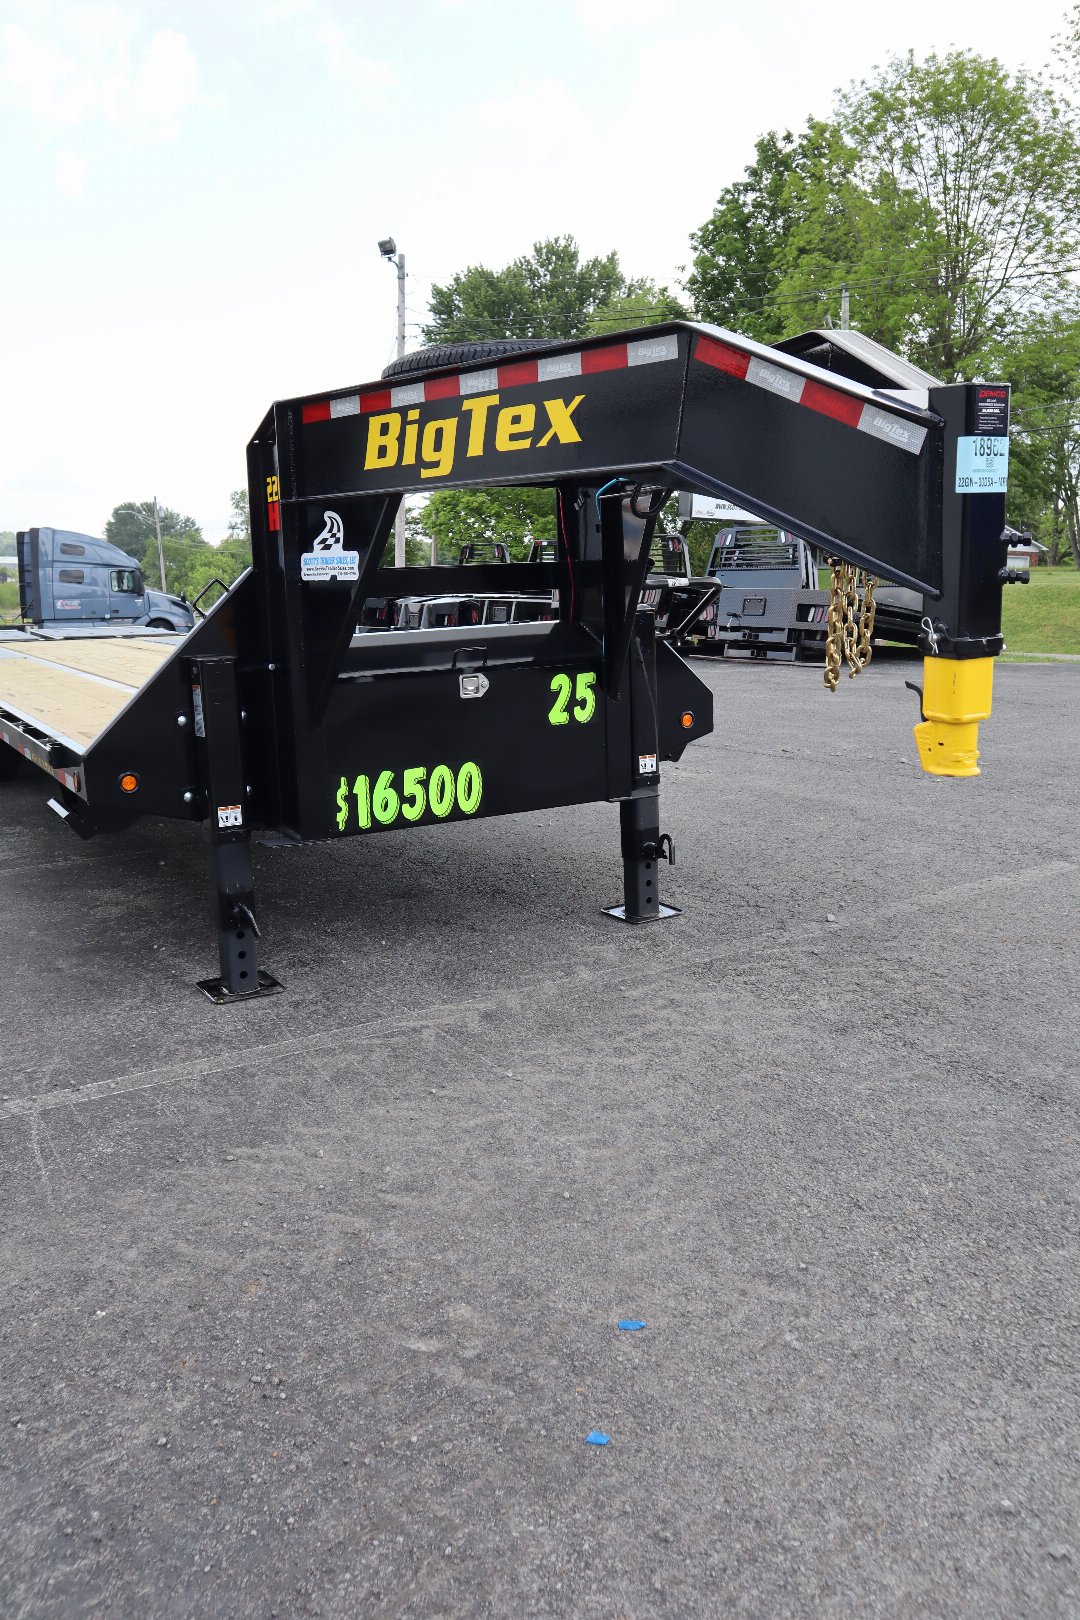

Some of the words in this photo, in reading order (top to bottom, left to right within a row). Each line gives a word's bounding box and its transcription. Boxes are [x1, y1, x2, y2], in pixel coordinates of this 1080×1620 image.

[979, 390, 1007, 398] DEMCO
[364, 394, 586, 478] BigTex
[873, 417, 911, 438] BigTex
[349, 555, 357, 565] LLC
[548, 672, 597, 725] 25
[336, 761, 483, 832] $16500
